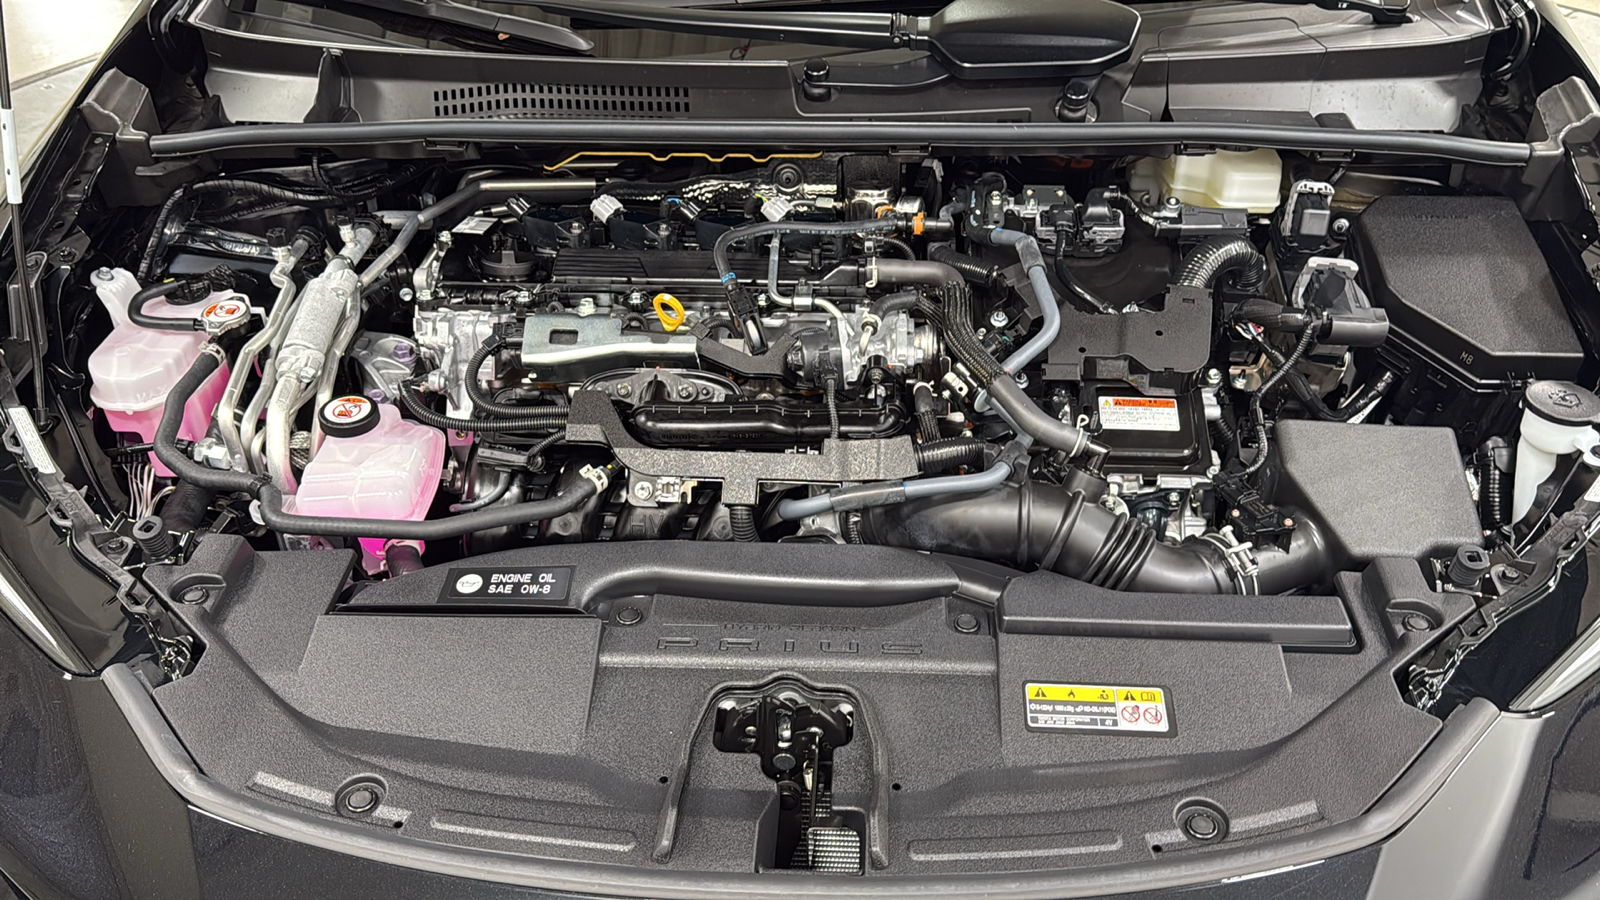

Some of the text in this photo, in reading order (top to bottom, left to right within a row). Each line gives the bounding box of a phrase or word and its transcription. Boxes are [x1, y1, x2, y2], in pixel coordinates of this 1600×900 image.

[630, 513, 665, 535] HV
[490, 572, 557, 583] ENGINE OIL
[487, 584, 514, 594] SAE
[657, 636, 923, 655] PRIUS
